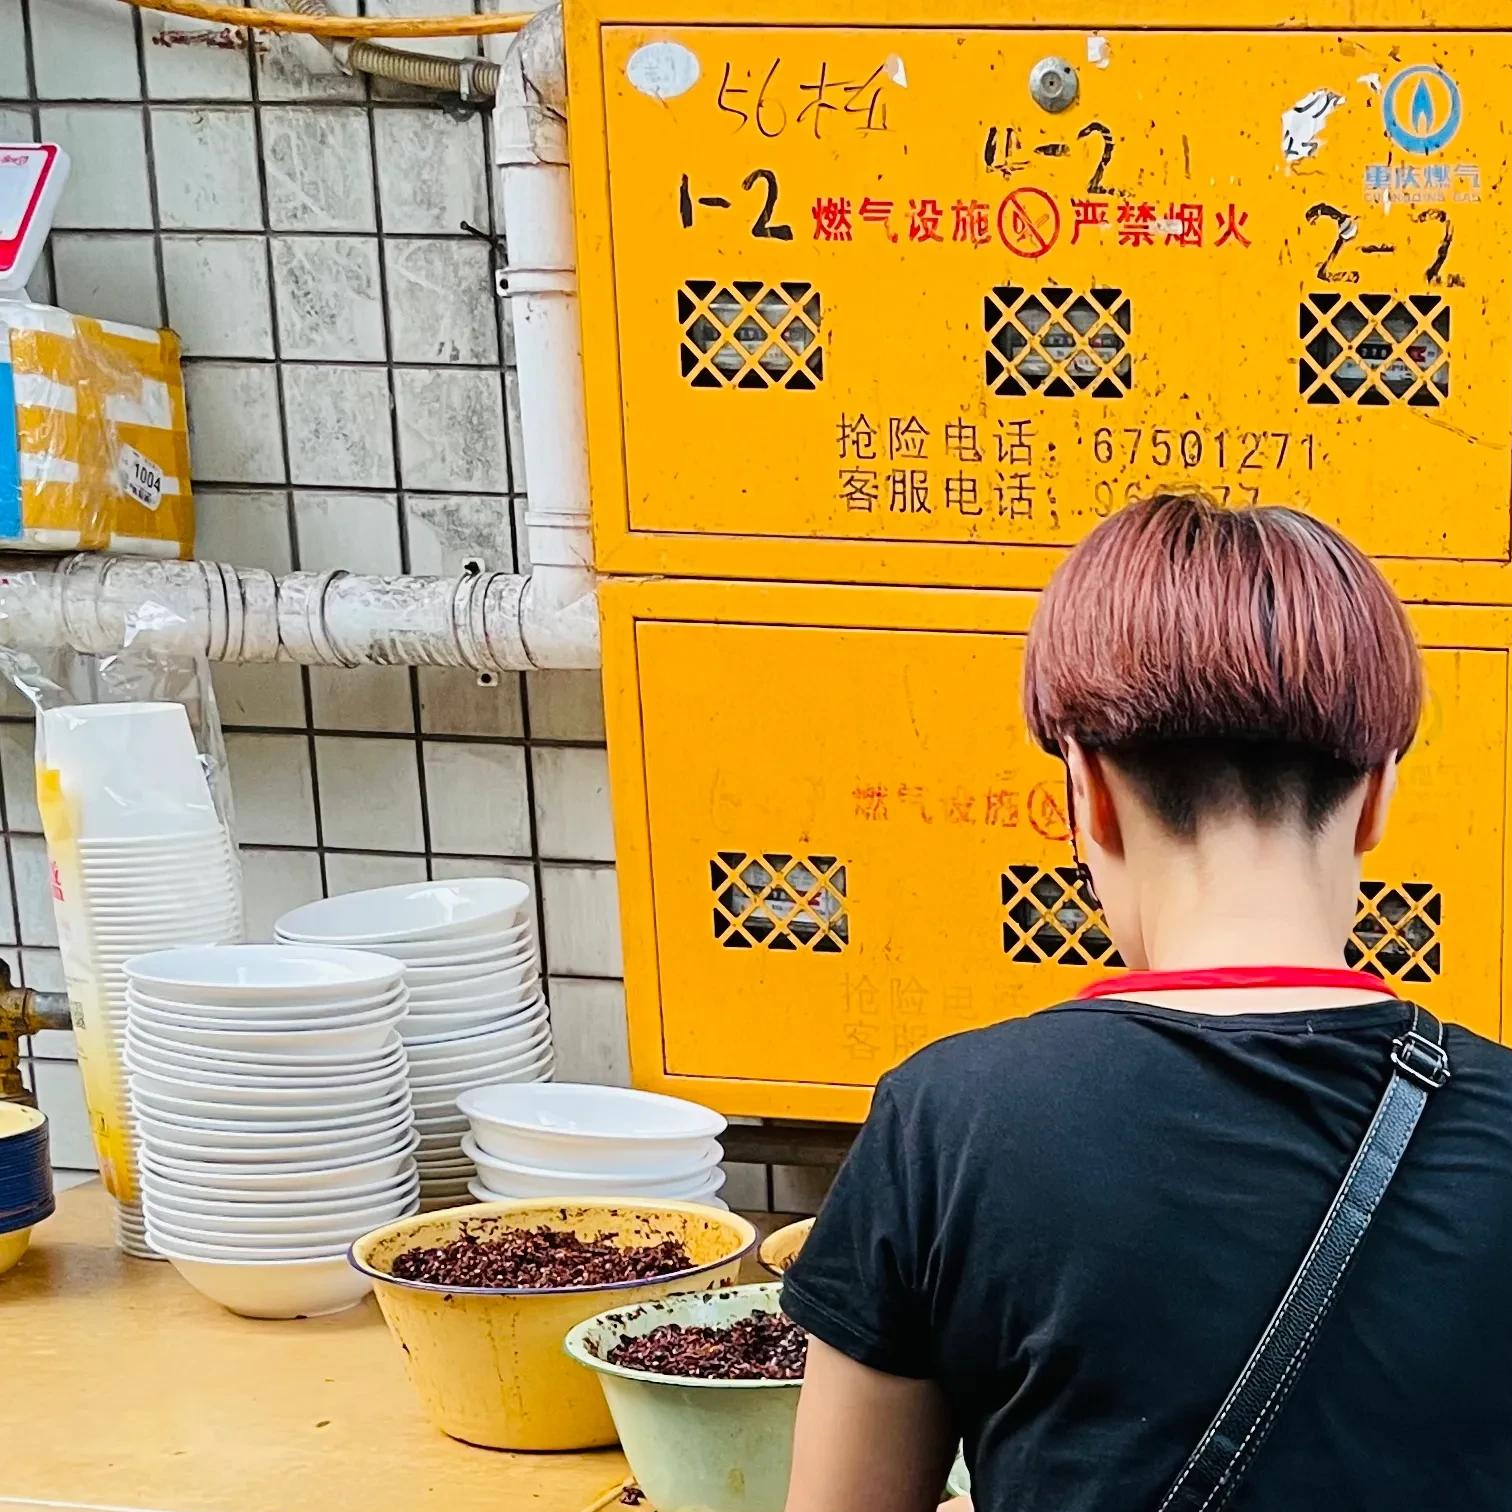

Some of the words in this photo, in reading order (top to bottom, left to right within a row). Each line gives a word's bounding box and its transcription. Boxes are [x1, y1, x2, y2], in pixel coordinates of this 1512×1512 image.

[679, 168, 794, 241] 1-2
[811, 197, 992, 248] 燃气设施
[1070, 199, 1252, 250] 严禁烟火
[1093, 427, 1316, 471] 67501271
[134, 463, 161, 493] 1004
